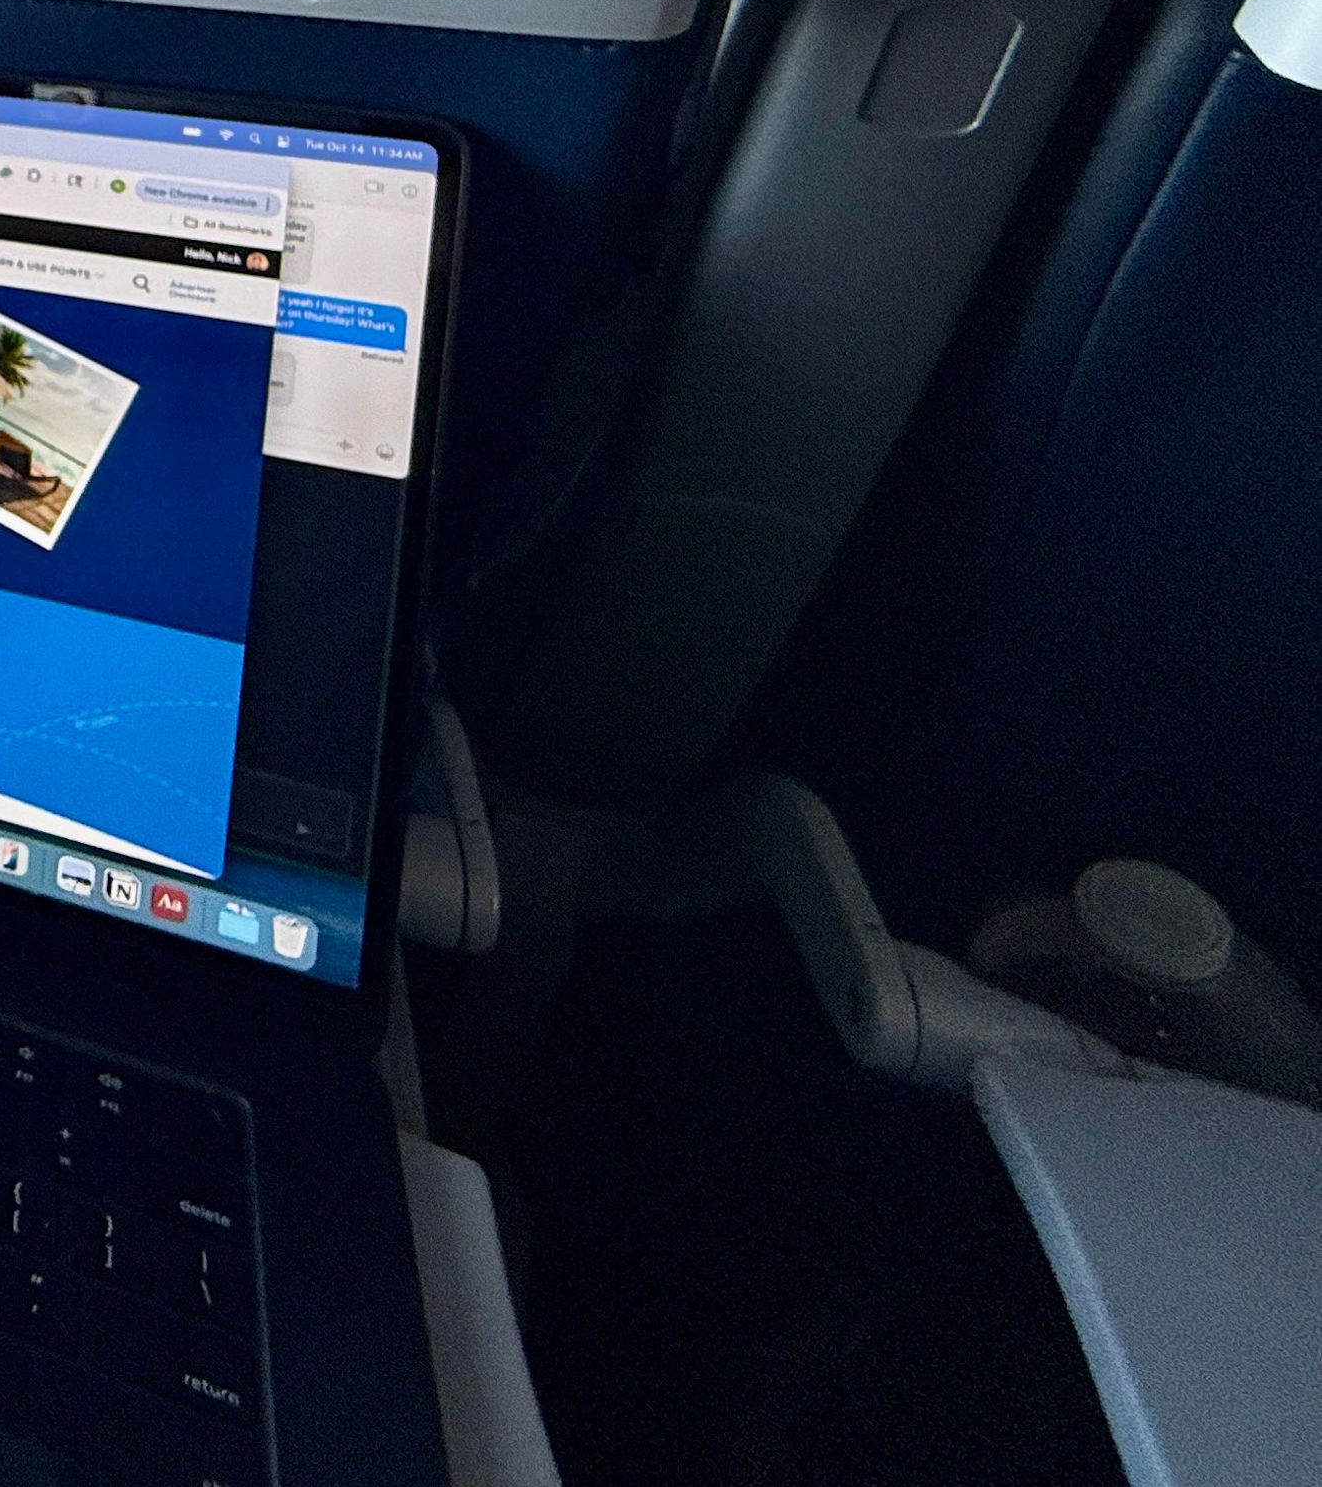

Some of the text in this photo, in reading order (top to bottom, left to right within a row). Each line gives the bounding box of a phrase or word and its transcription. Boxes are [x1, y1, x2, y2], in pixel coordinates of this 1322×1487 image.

[306, 138, 324, 150] Tue
[327, 141, 347, 154] Oct
[184, 1373, 240, 1406] return
